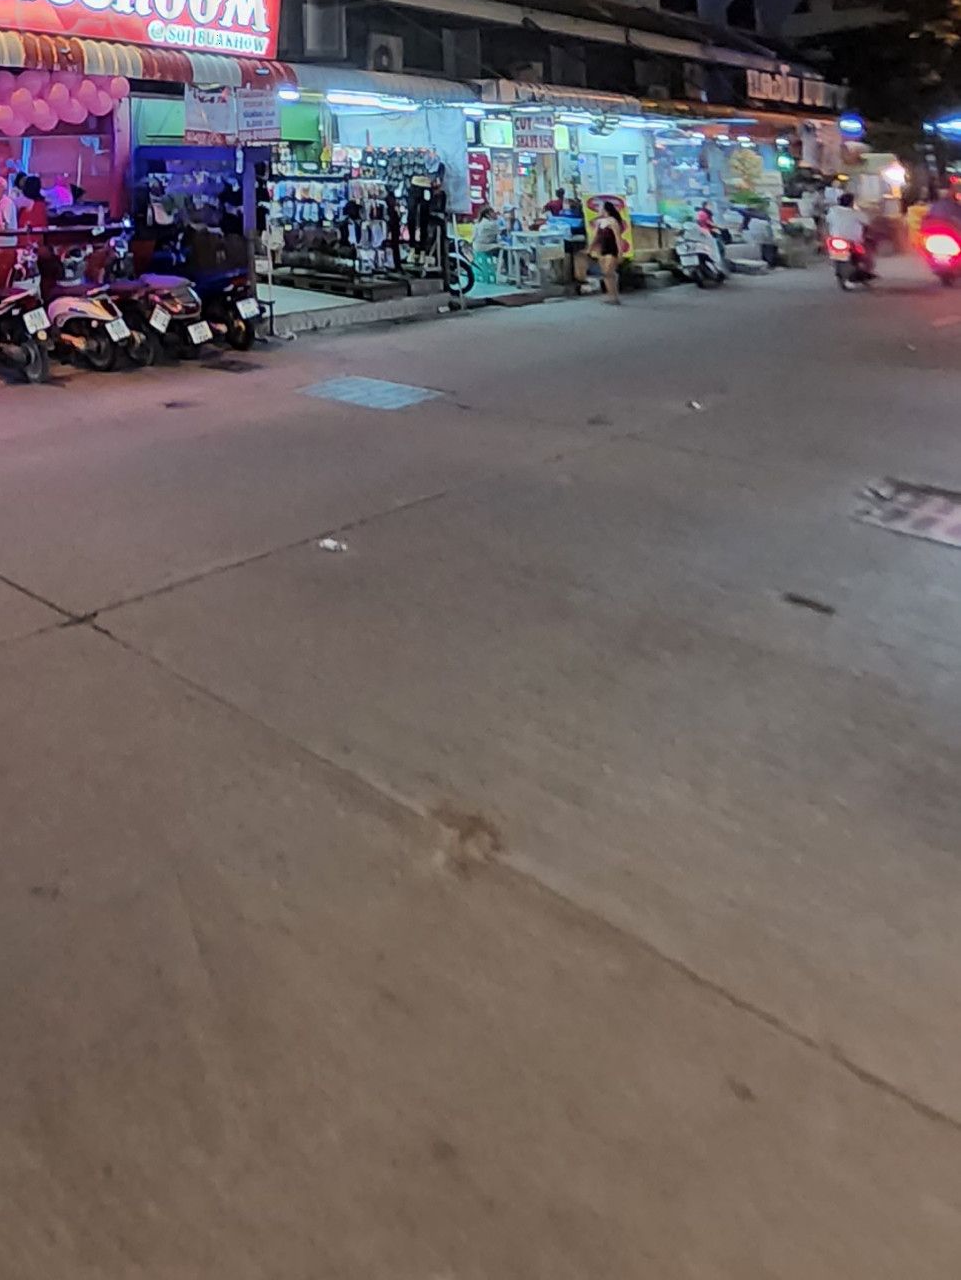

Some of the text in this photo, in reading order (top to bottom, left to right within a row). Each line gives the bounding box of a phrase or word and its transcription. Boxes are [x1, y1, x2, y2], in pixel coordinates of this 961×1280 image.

[149, 22, 267, 53] @ SOI BUAKHOW
